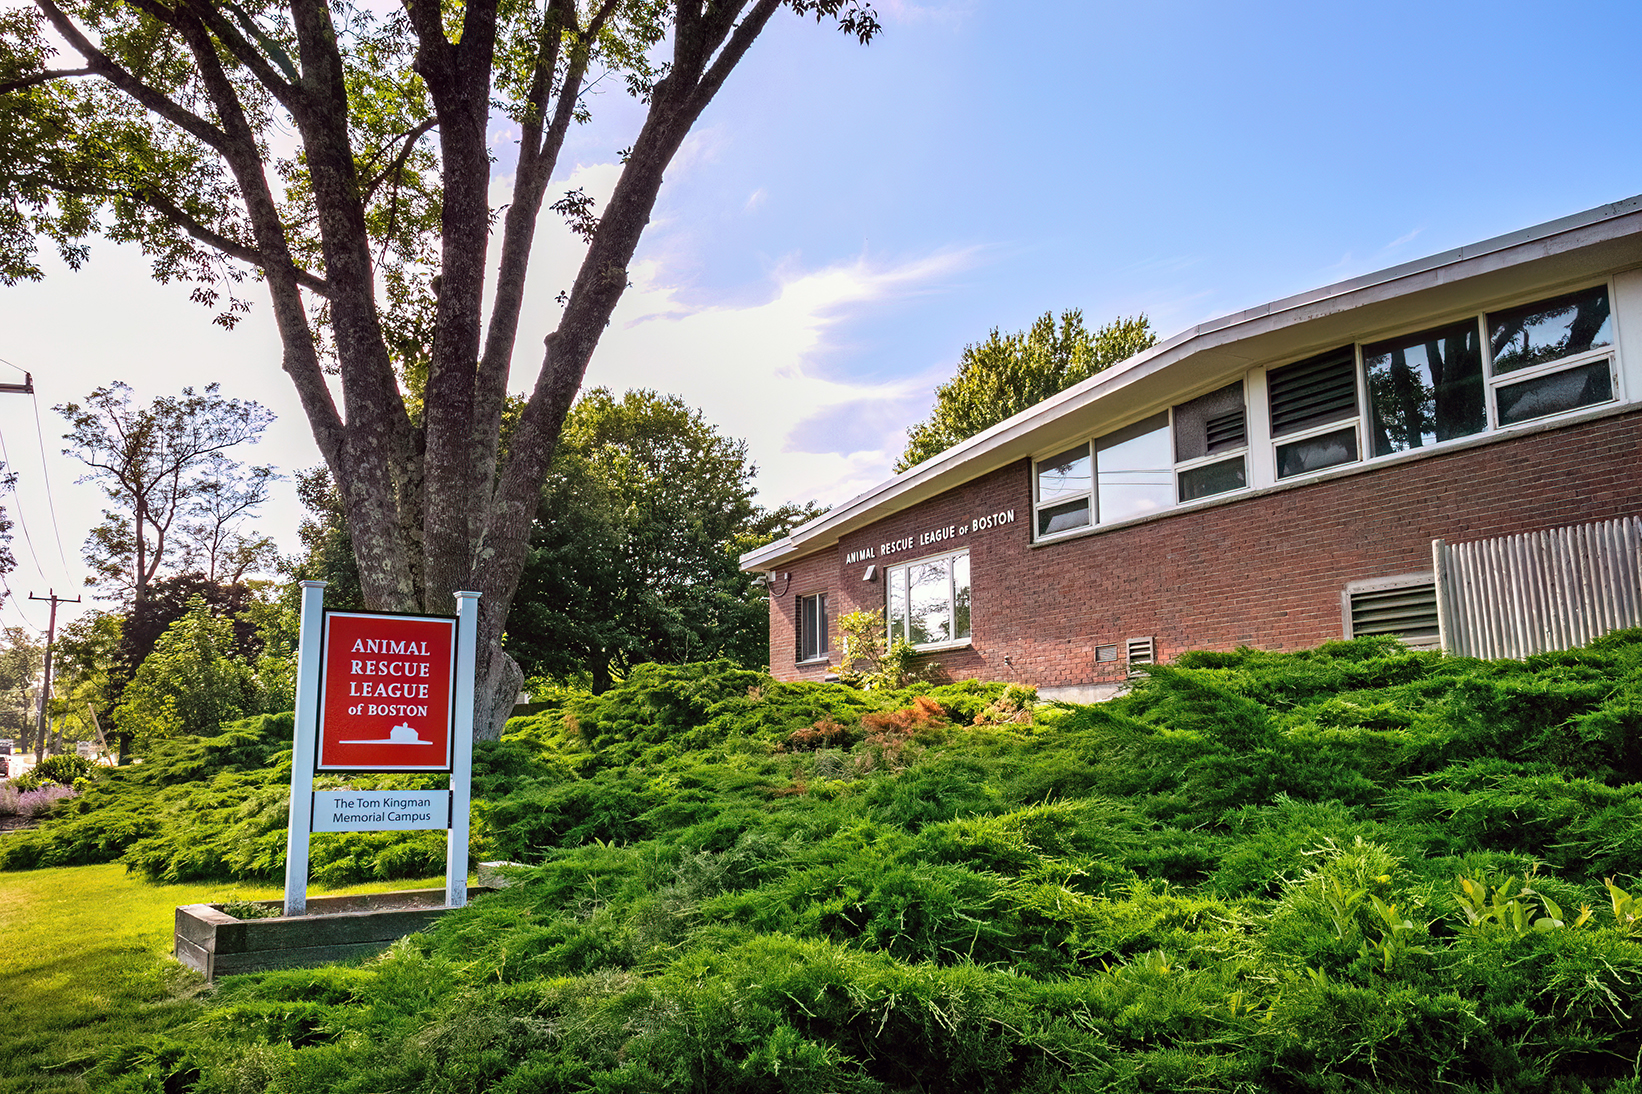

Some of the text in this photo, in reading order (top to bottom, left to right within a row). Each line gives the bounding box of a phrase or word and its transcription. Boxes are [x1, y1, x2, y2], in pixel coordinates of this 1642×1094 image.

[846, 509, 1015, 565] ANIMAL RESCUE LEAGUE OF BOSTON
[351, 638, 431, 656] ANIMAL
[350, 659, 430, 677] RESCUE
[349, 681, 429, 699] LEAGUE
[348, 703, 428, 717] of BOSTON
[334, 798, 431, 810] The Tom Kingman
[332, 811, 431, 823] Memorial Campus
